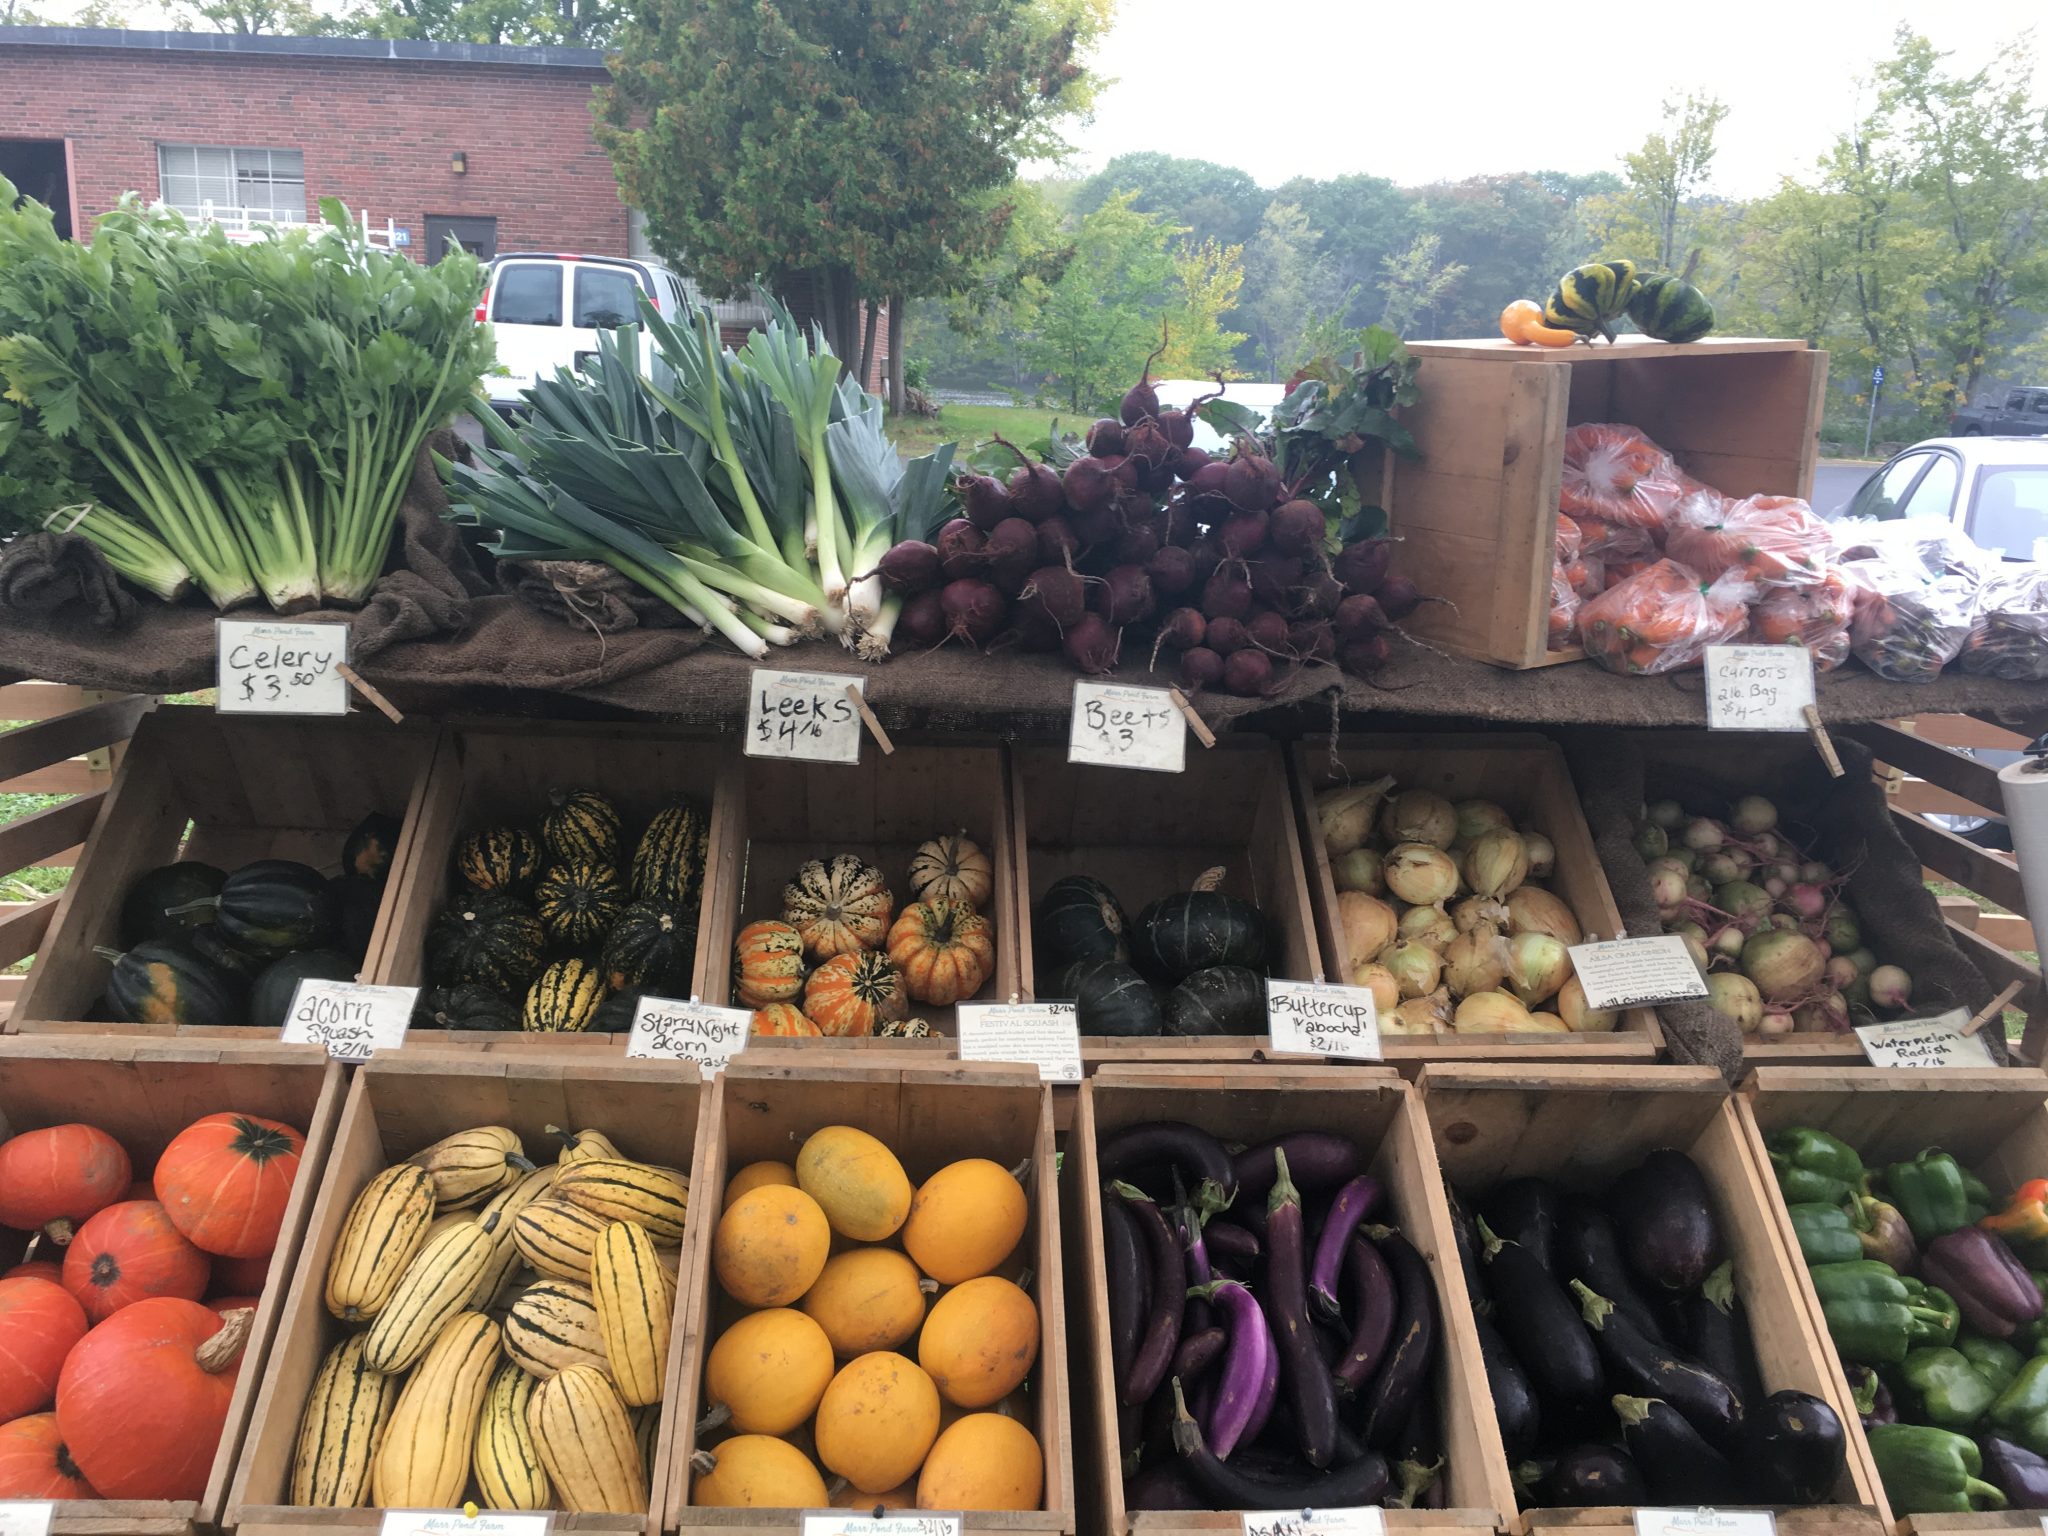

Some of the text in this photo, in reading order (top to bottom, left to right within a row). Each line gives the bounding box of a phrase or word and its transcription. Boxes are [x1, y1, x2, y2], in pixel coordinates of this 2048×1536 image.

[229, 645, 332, 674] Celery
[1750, 684, 1777, 706] Bag
[1085, 700, 1171, 730] Beets
[297, 996, 374, 1027] acorn
[980, 1019, 1058, 1028] FESTIVAL SQUASH
[1269, 995, 1367, 1029] Buttercup
[641, 1013, 740, 1043] Starry Night
[1870, 1032, 1959, 1049] Watermelon
[652, 1034, 707, 1053] acorn
[1896, 1045, 1952, 1059] Radish
